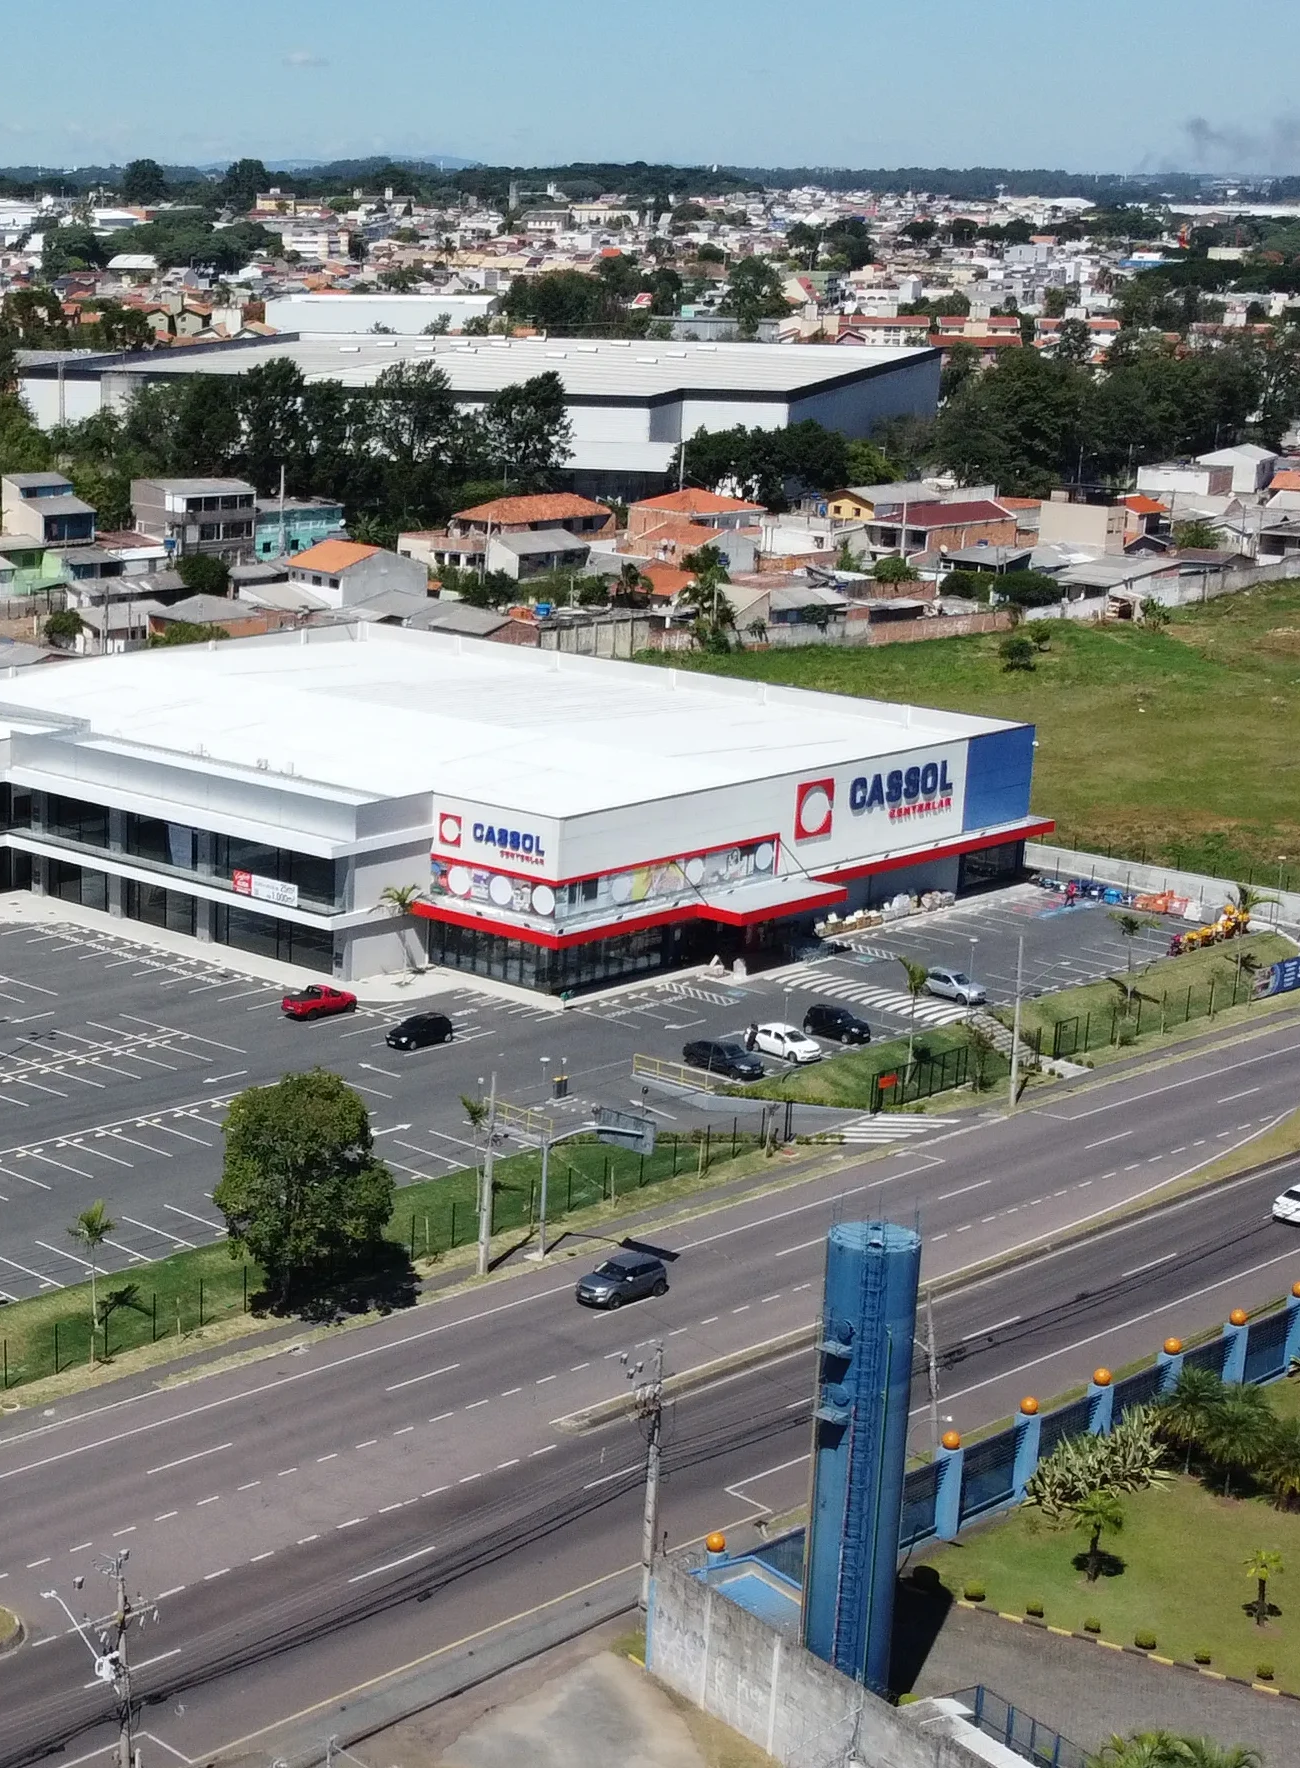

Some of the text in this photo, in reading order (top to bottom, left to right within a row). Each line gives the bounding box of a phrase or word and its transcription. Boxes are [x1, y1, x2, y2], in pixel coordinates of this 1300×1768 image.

[850, 759, 953, 812] CASSOL
[888, 797, 952, 819] CENTERLAR
[472, 822, 545, 857] CASSOL
